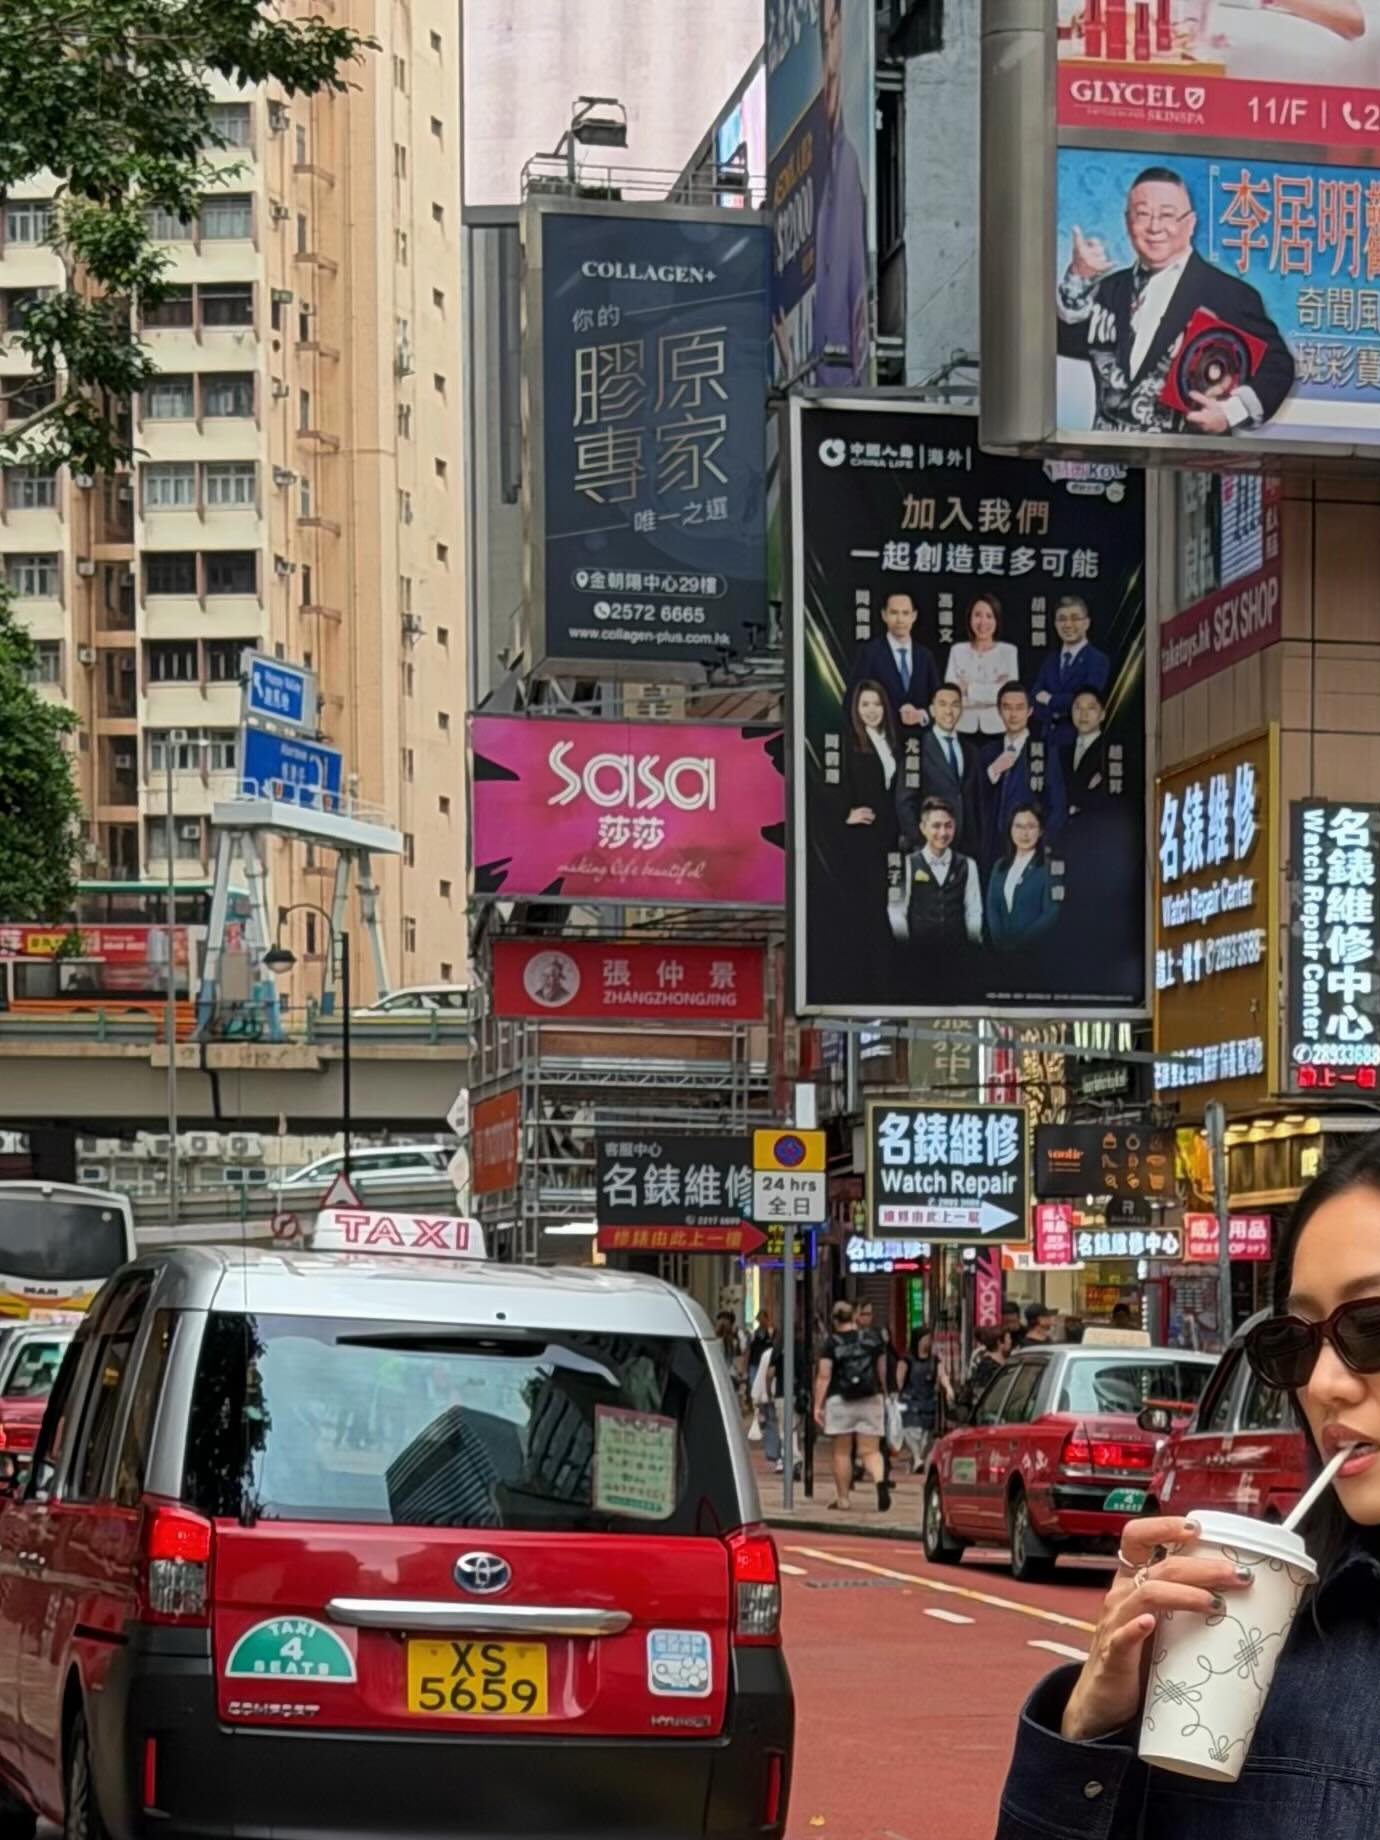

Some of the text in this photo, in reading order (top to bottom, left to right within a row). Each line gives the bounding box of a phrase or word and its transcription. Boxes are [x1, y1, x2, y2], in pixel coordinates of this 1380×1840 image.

[1070, 79, 1181, 109] GLYCEL
[1247, 96, 1308, 124] 11/F
[581, 259, 718, 284] COLLAGEN+
[571, 303, 622, 333] 你的
[573, 326, 729, 428] 膠原
[573, 412, 730, 504] 專家
[901, 492, 1050, 536] 加入我們
[851, 540, 1100, 579] 一起創造更多可能
[610, 602, 706, 624] 2572 6665
[1213, 600, 1241, 652] SEX
[1240, 576, 1279, 636] SHOP
[598, 814, 665, 850] 莎莎
[1159, 762, 1257, 883] 名錶維修
[1300, 808, 1325, 1040] Watch Repair Center
[1326, 807, 1377, 1042] 名錶維修中心
[603, 958, 736, 988] 張仲景
[603, 990, 737, 1007] ZHANGZHONGJING
[878, 1111, 1020, 1167] 名錶維修
[762, 1176, 817, 1192] 24 hrs
[880, 1168, 1018, 1199] Watch Repair
[767, 1196, 811, 1217] 全日
[335, 1214, 470, 1251] TAXI
[268, 1621, 317, 1638] TAXI
[280, 1637, 304, 1660] 4
[451, 1643, 507, 1678] XS
[254, 1660, 330, 1676] SEATS
[418, 1675, 538, 1714] 5659
